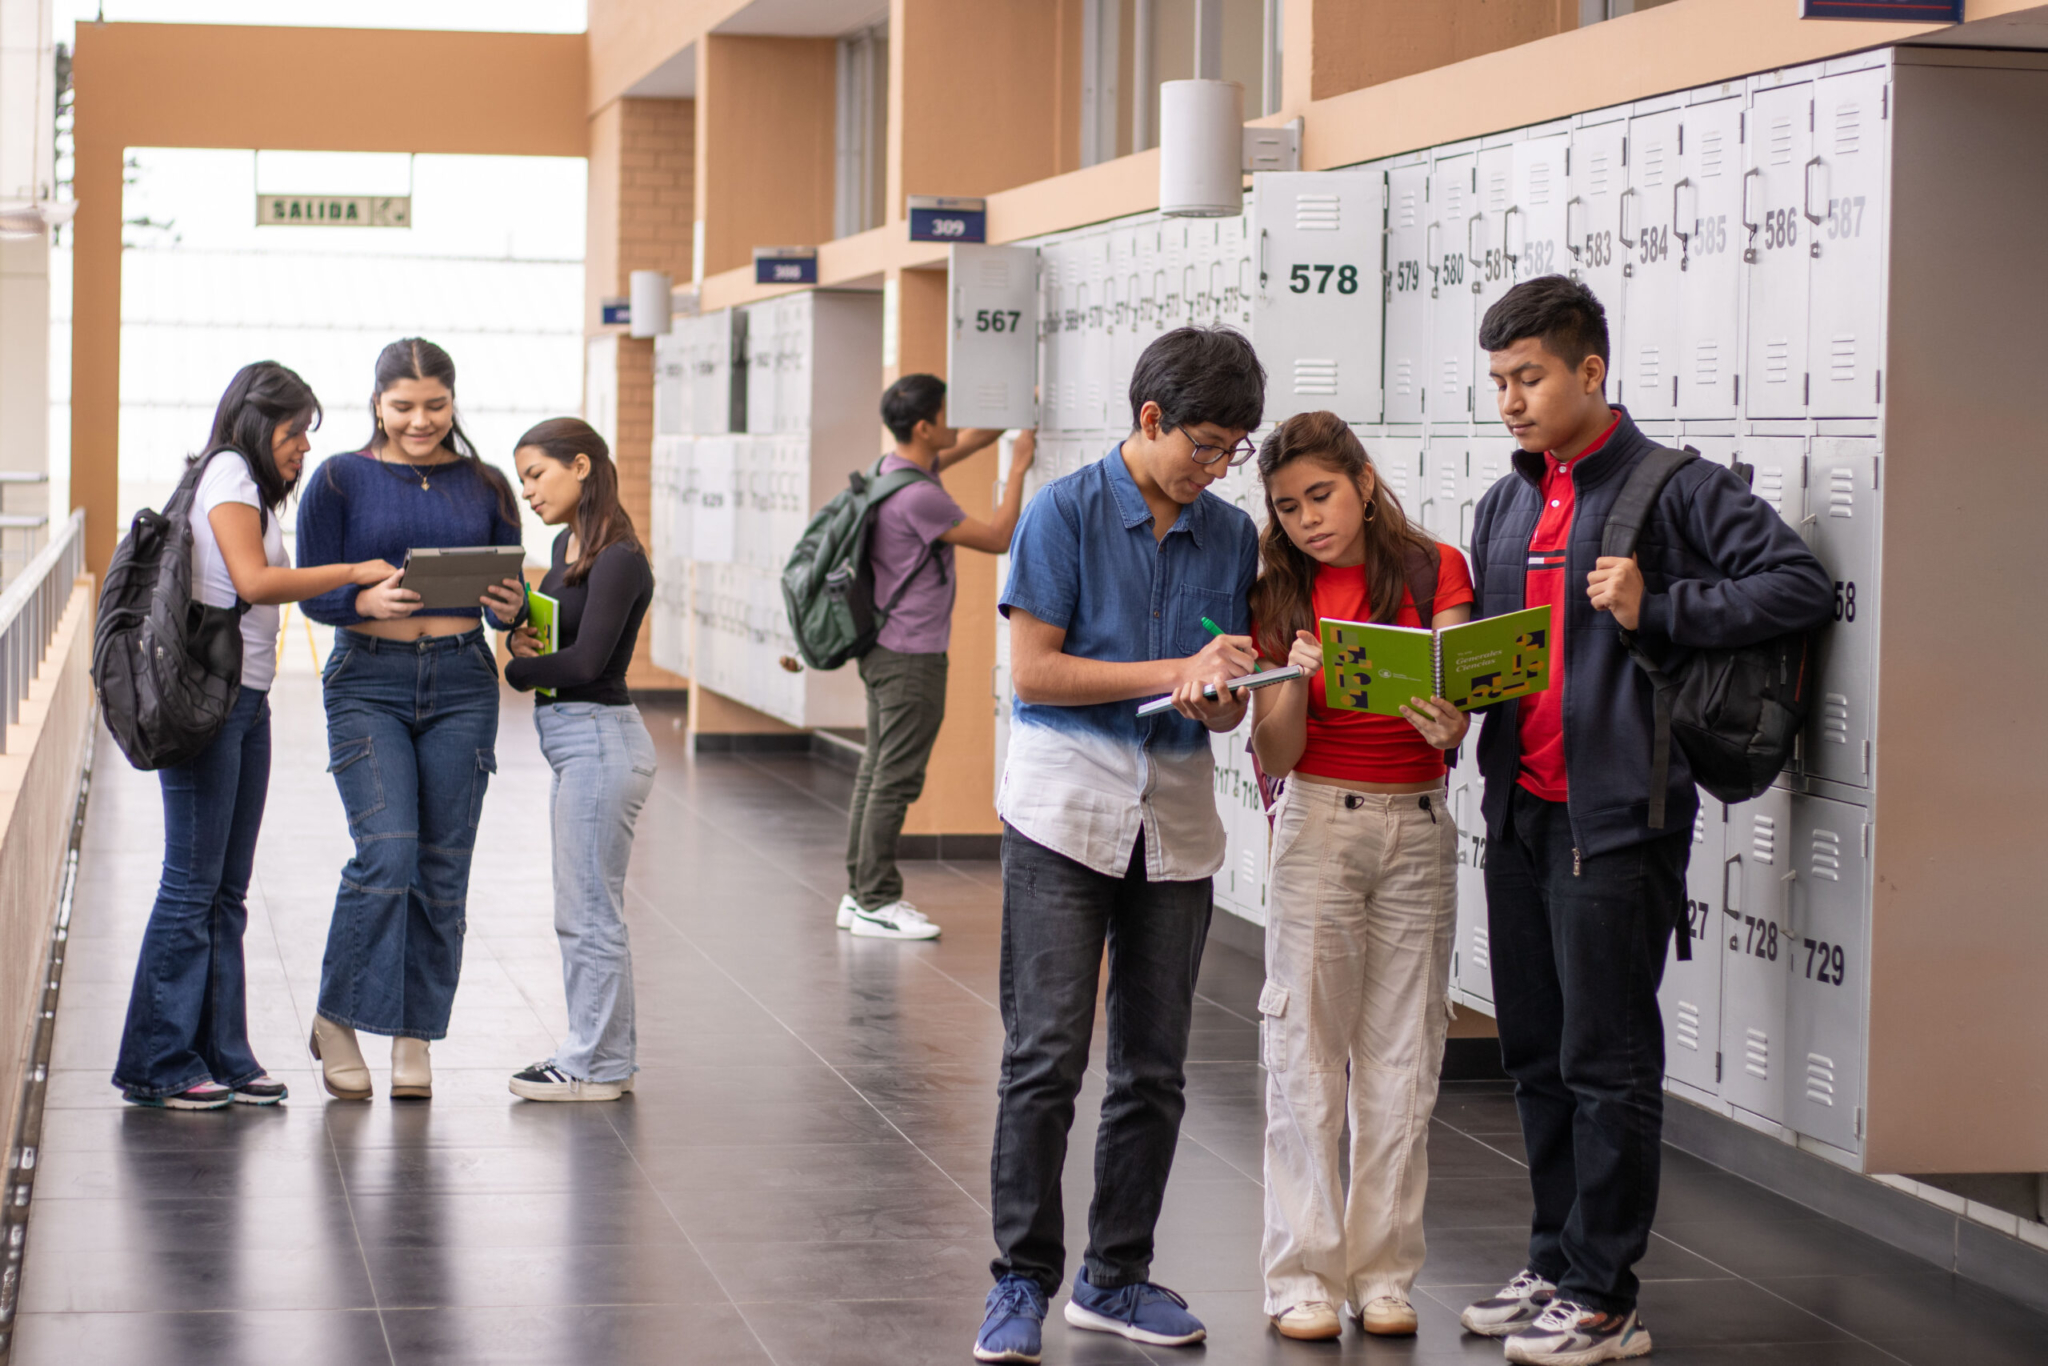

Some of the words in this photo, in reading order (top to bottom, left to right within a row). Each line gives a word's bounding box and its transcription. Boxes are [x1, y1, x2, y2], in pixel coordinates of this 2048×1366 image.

[273, 201, 358, 220] SALIDA
[931, 218, 966, 237] 309
[1765, 206, 1798, 250] 586
[1827, 195, 1866, 240] 587
[1586, 230, 1611, 268] 583
[1640, 224, 1668, 264] 584
[1694, 214, 1727, 257] 585
[1397, 260, 1420, 292] 579
[1443, 253, 1464, 286] 580
[1485, 248, 1508, 281] 581
[1524, 239, 1555, 277] 582
[1289, 263, 1359, 295] 578
[976, 310, 1021, 333] 567
[1834, 581, 1856, 623] 58
[1242, 780, 1260, 811] 718
[1472, 835, 1486, 870] 72
[1687, 899, 1709, 941] 27
[1745, 914, 1778, 962] 728
[1804, 937, 1845, 987] 729
